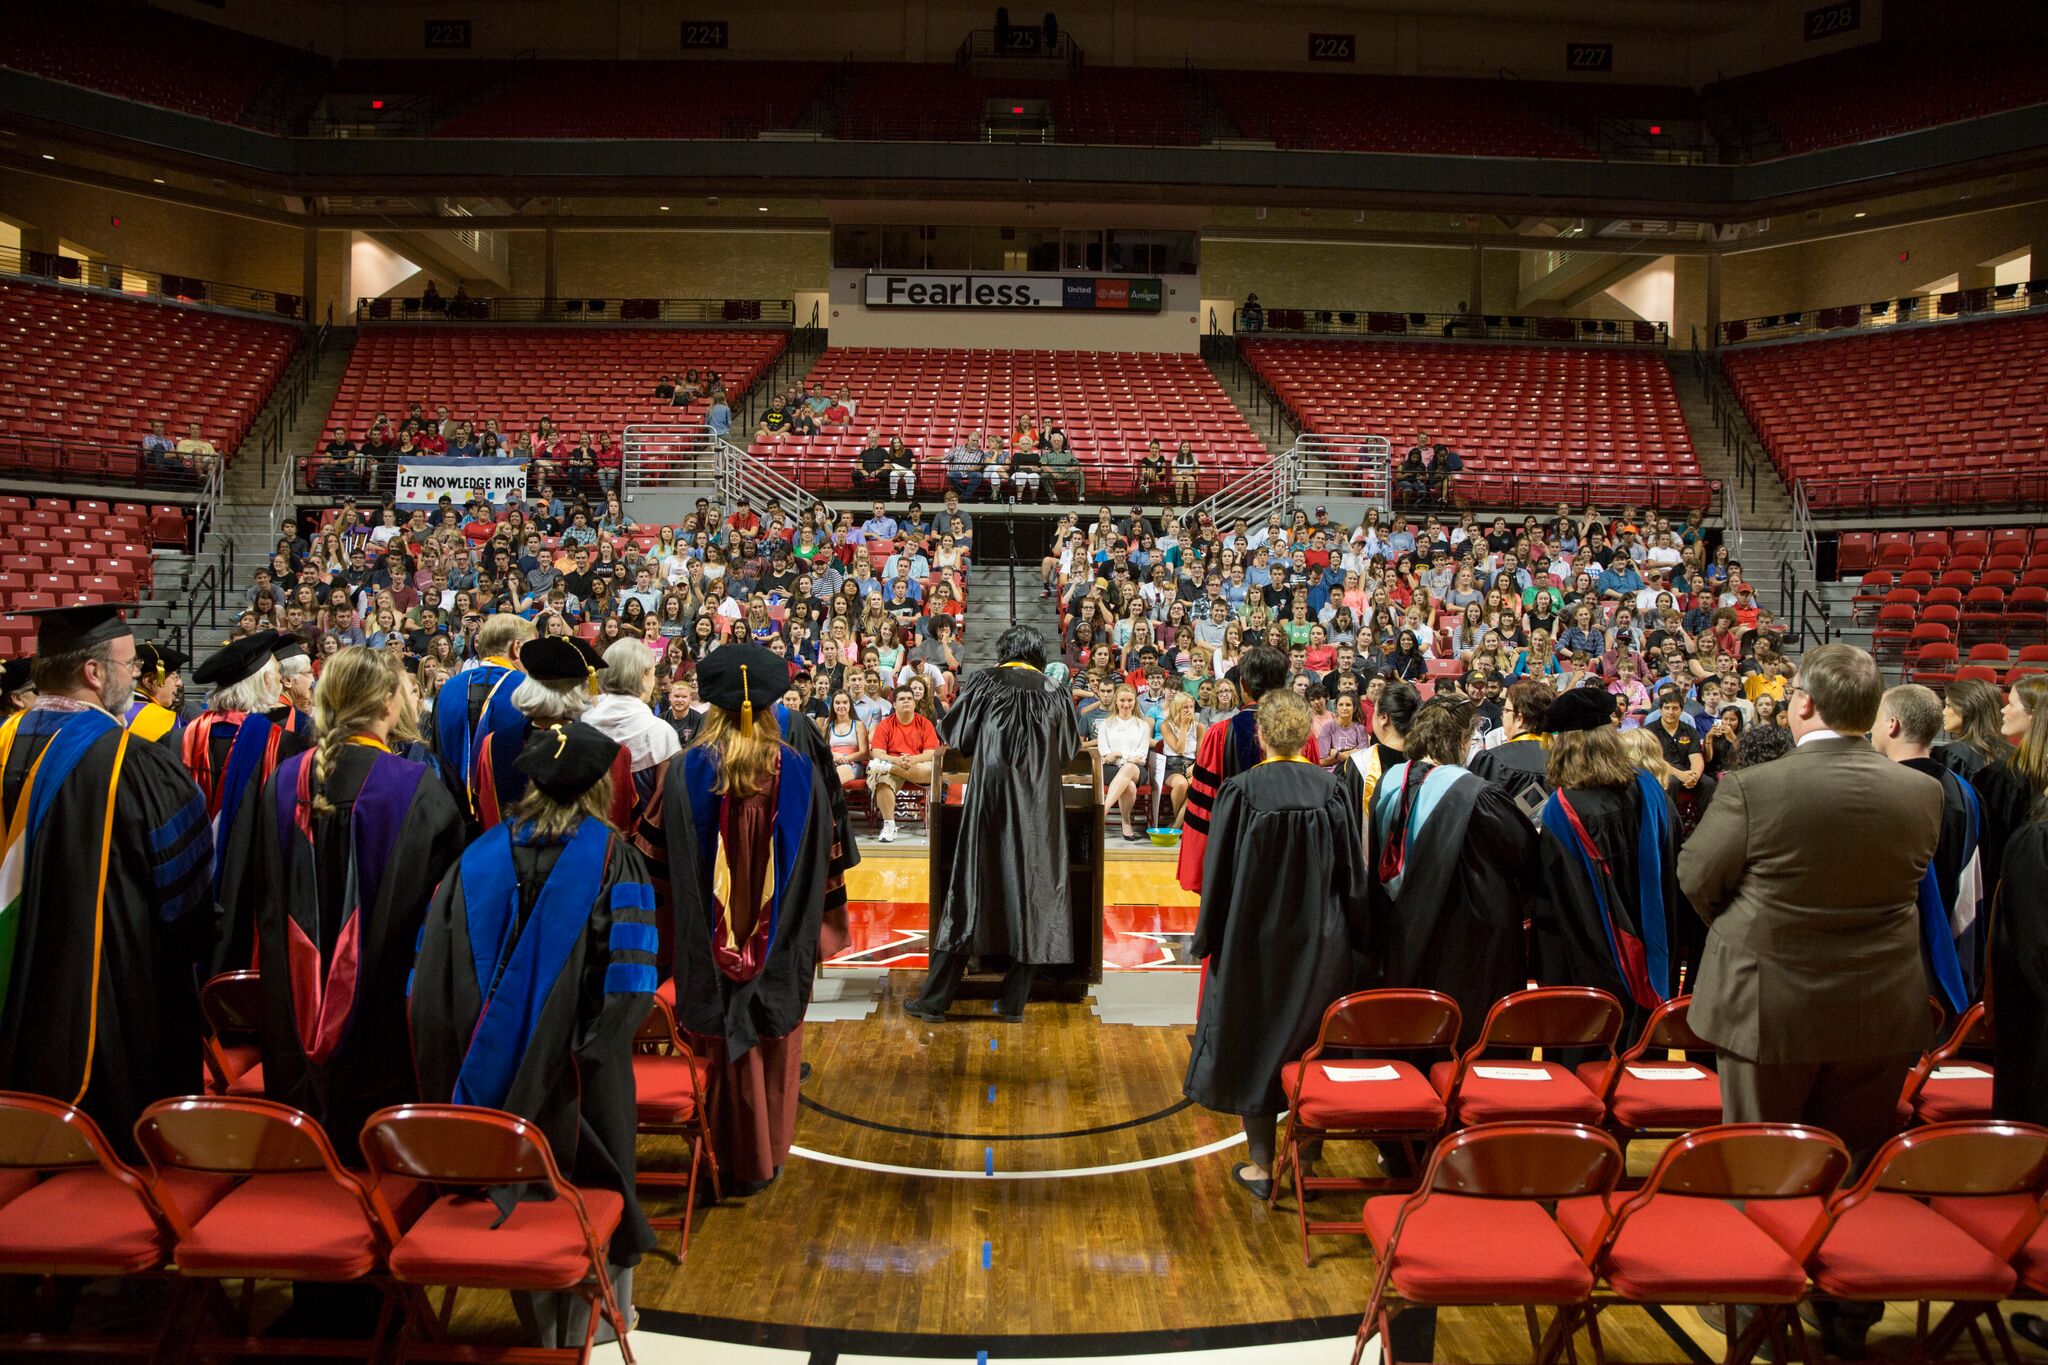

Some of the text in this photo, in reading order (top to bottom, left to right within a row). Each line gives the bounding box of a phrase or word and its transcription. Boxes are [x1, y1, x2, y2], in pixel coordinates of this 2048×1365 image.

[1811, 6, 1852, 35] 228
[431, 25, 465, 43] 223
[687, 26, 722, 44] 224
[1007, 31, 1034, 49] 25
[1314, 38, 1349, 57] 226
[1573, 48, 1607, 66] 227
[887, 276, 1040, 305] Fearless.
[1130, 290, 1160, 302] Amigos
[400, 476, 419, 487] LET
